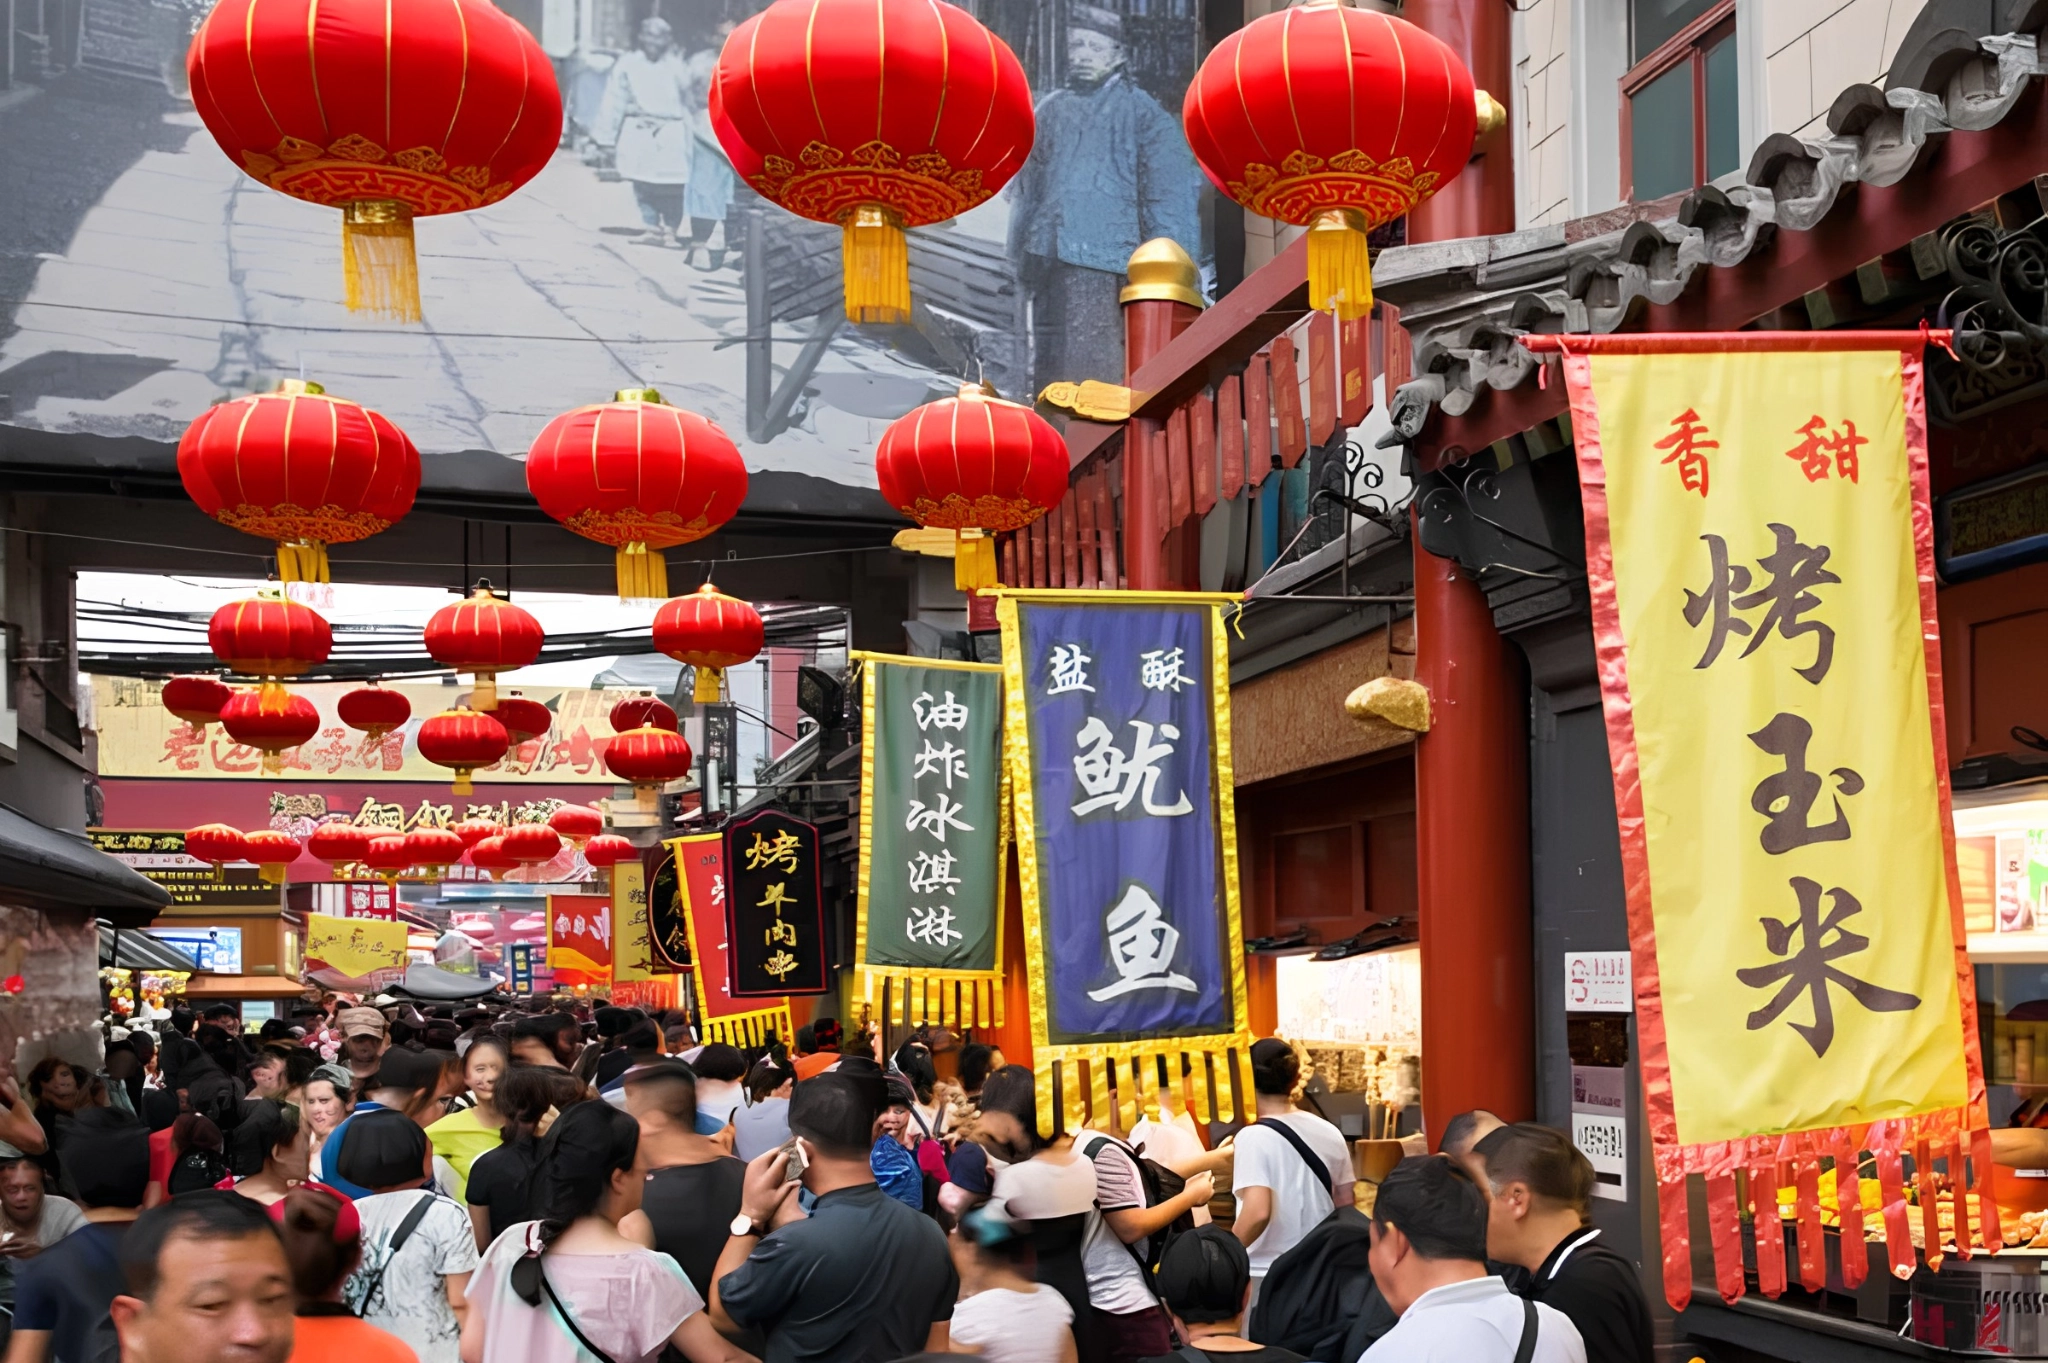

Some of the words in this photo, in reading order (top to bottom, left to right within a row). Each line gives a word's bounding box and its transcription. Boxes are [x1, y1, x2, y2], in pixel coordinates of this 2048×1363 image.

[906, 690, 975, 947] 油炸冰淇淋
[1071, 715, 1200, 1003] 鱿鱼
[1683, 522, 1922, 1059] 烤玉米
